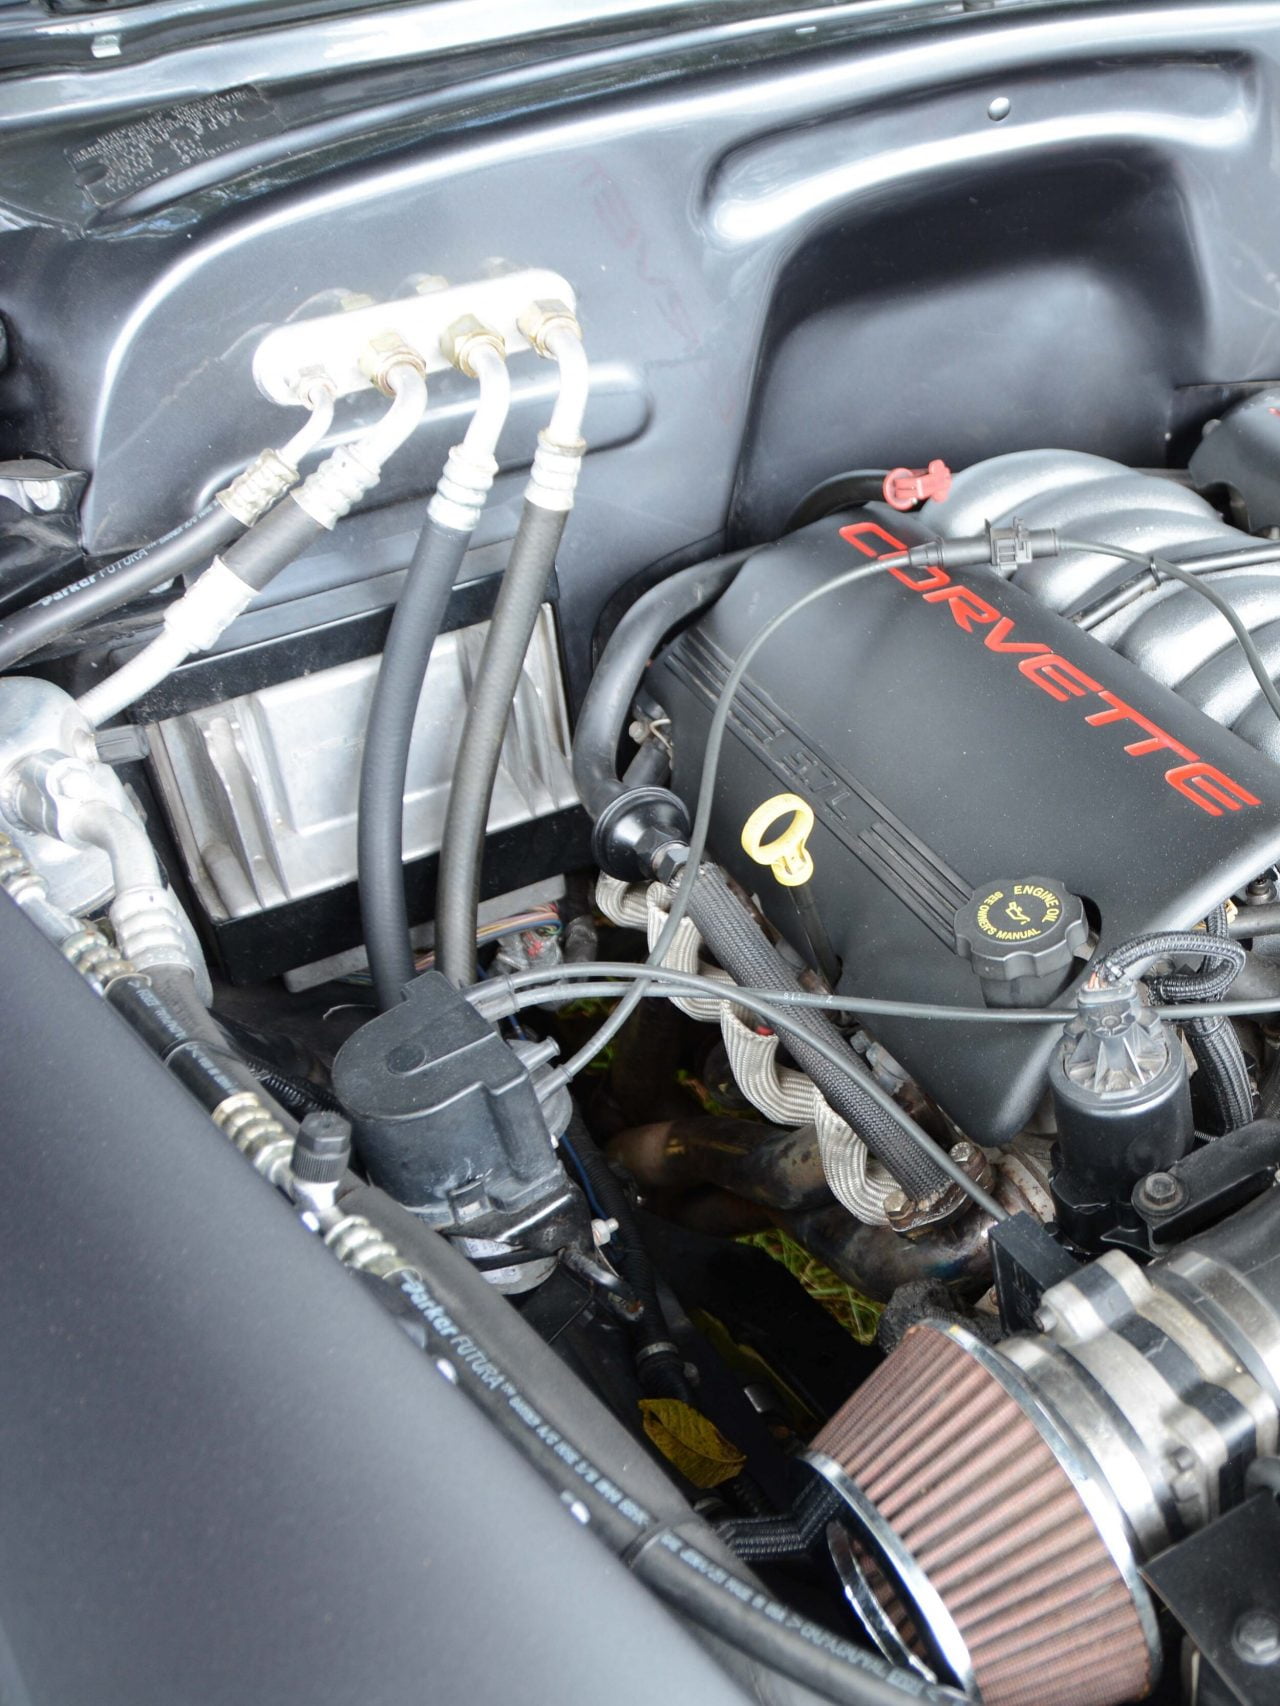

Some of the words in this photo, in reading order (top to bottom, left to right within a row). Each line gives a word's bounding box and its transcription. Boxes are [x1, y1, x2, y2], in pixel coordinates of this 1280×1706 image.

[838, 522, 1262, 817] CORVETTE
[984, 891, 1004, 906] SEE
[995, 928, 1042, 940] MANUAL
[1014, 885, 1060, 908] ENGINE
[1042, 908, 1060, 923] OIL
[400, 1271, 459, 1336] Parker
[450, 1334, 505, 1390] FUTURA
